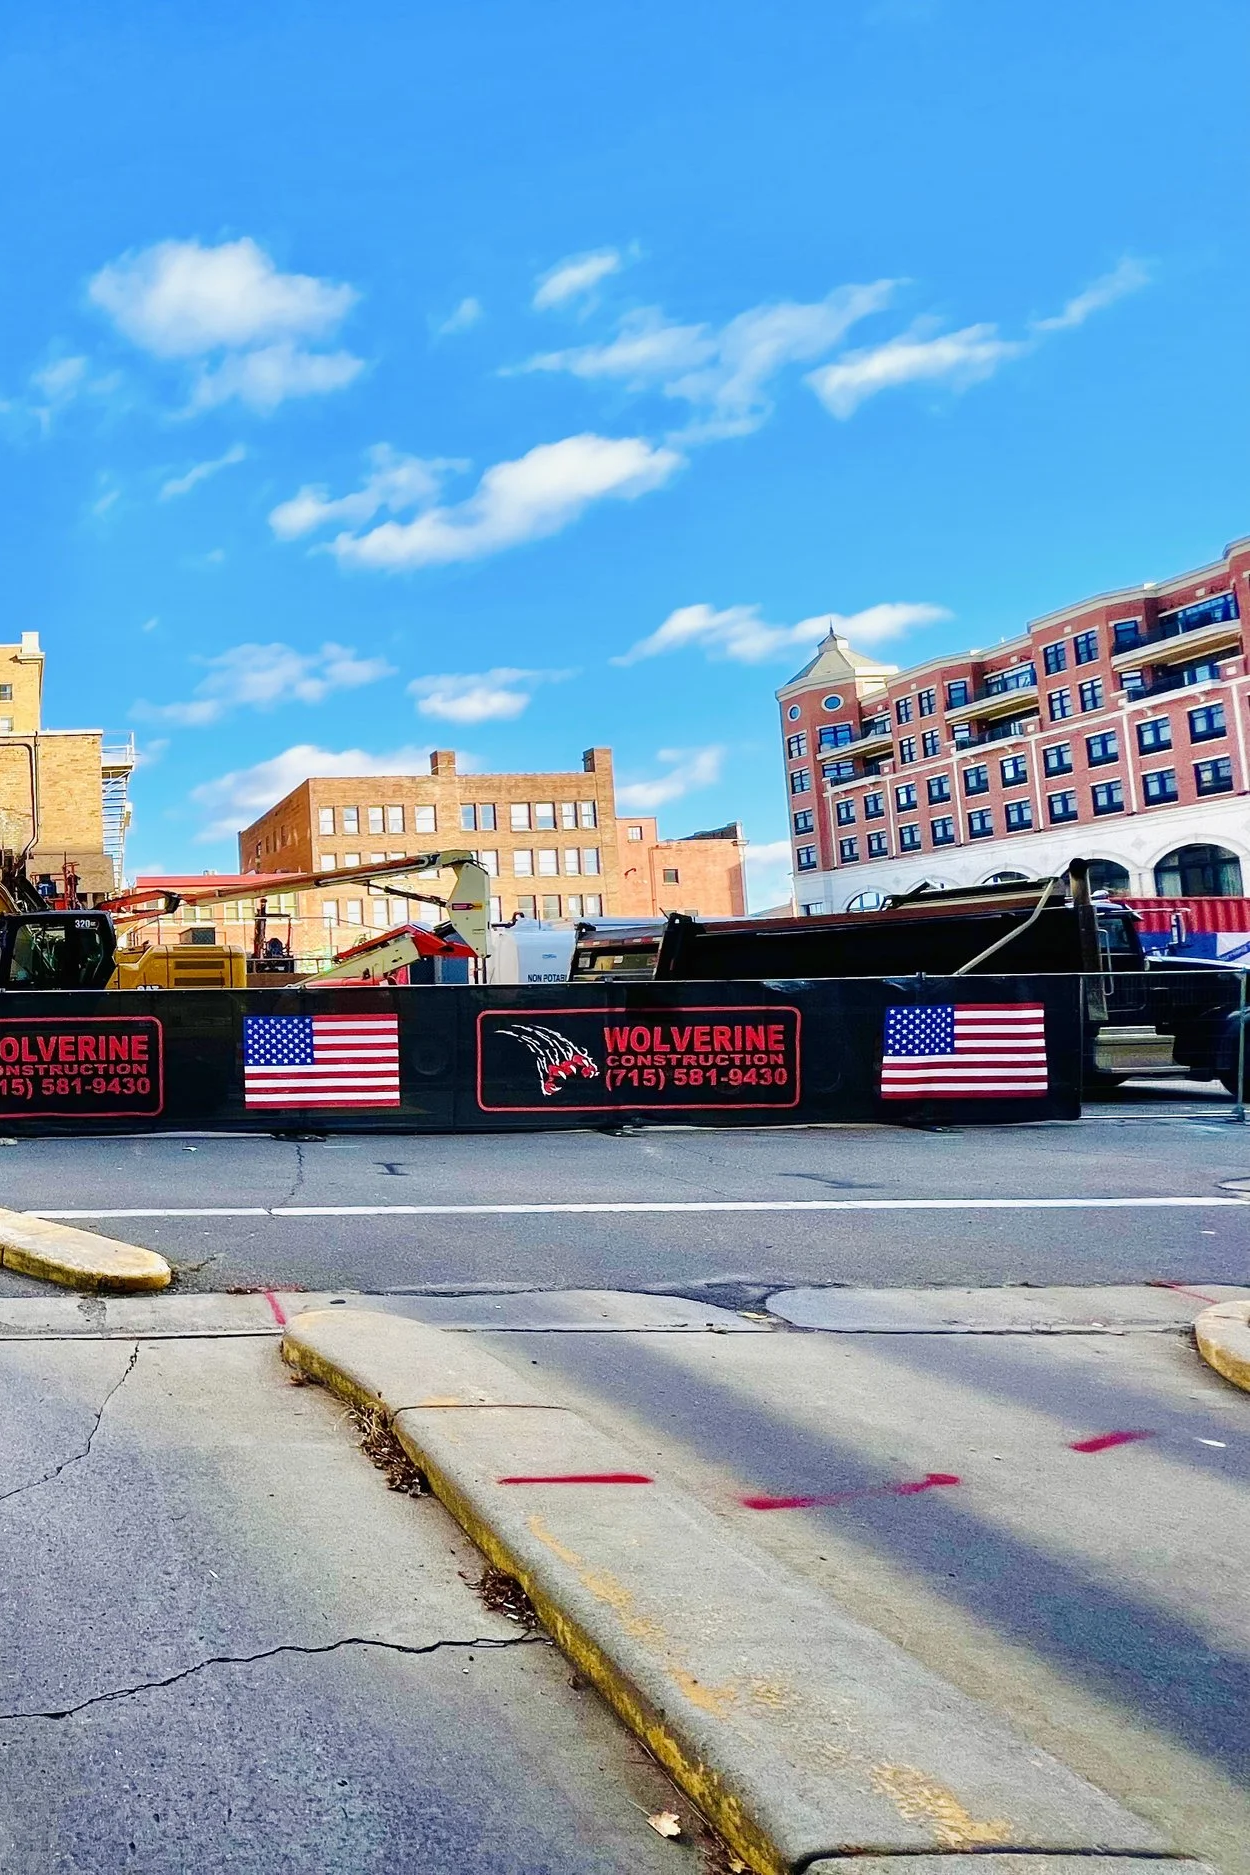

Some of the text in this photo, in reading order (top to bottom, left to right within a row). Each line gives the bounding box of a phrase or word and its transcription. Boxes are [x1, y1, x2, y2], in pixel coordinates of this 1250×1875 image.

[75, 919, 91, 929] 320
[527, 974, 543, 983] NON
[604, 1024, 786, 1053] WOLVERINE
[605, 1053, 785, 1067] CONSTRUCTION
[41, 1077, 151, 1096] 581-9430
[605, 1067, 788, 1092] (715) 581-9430
